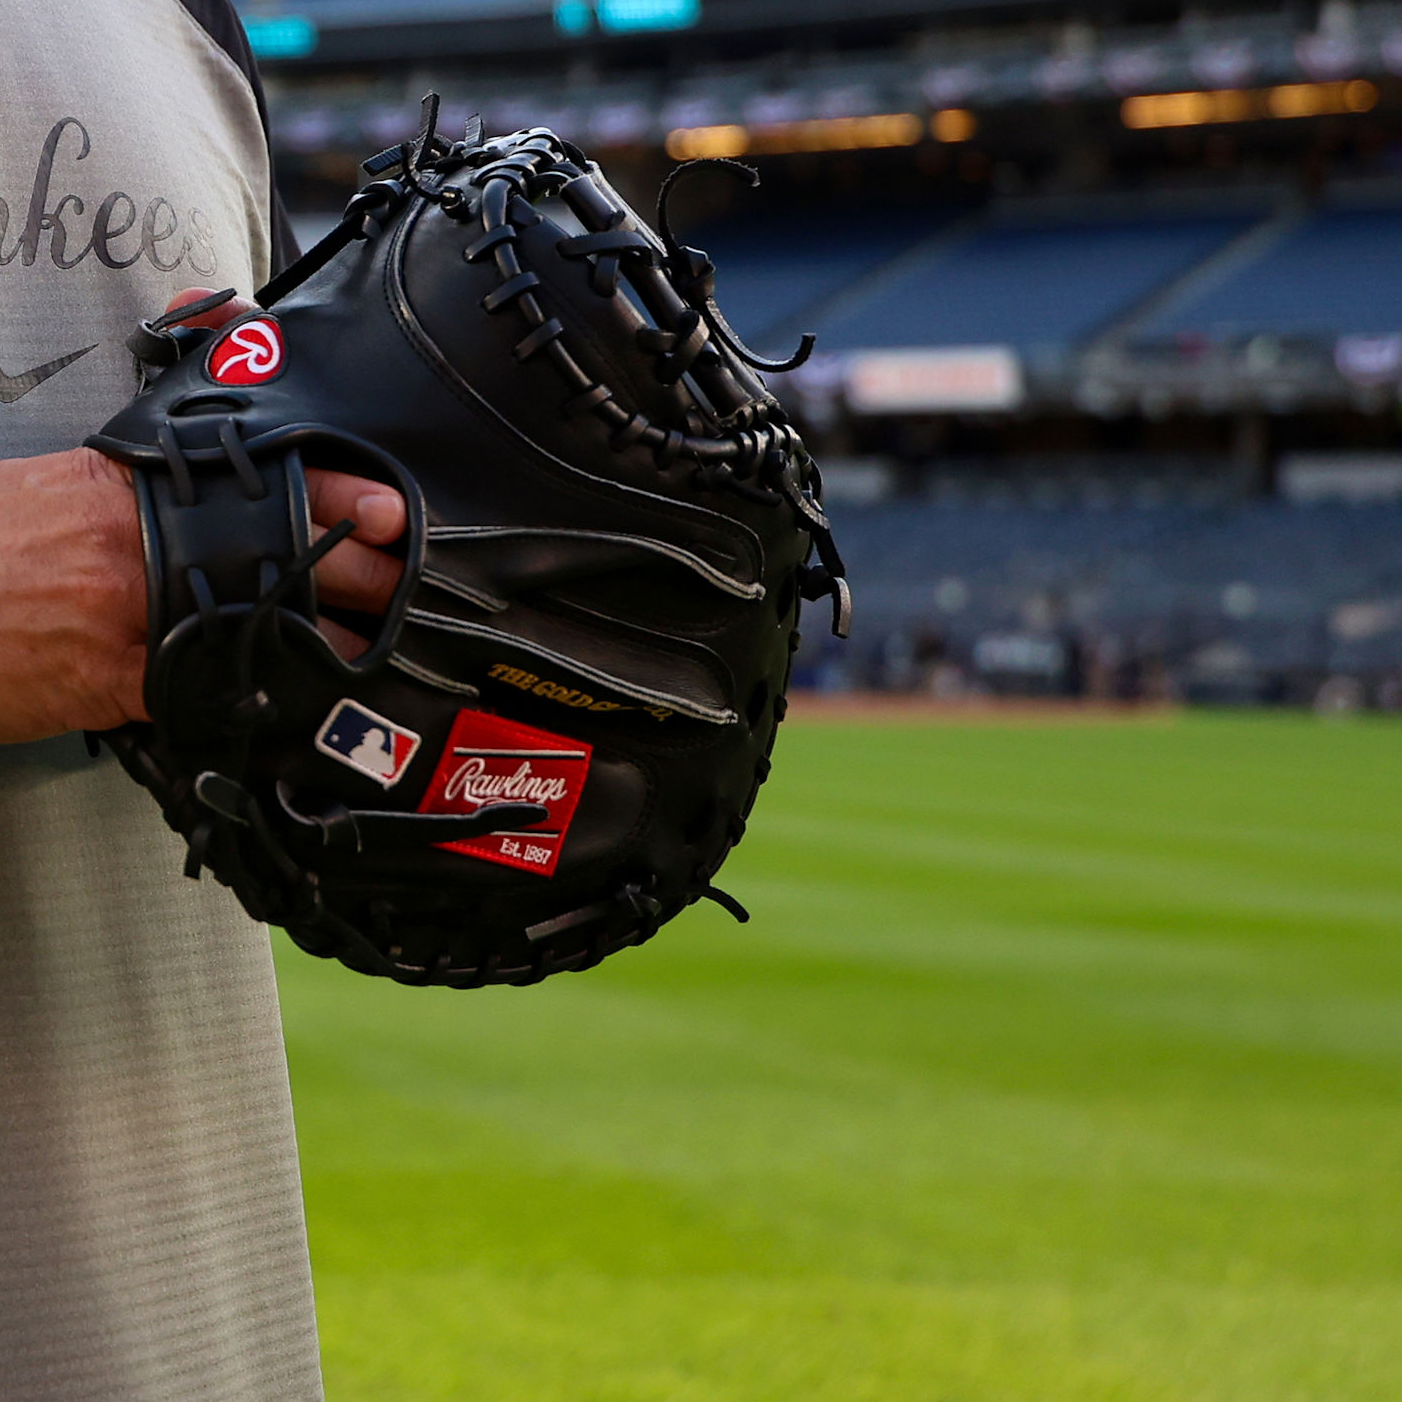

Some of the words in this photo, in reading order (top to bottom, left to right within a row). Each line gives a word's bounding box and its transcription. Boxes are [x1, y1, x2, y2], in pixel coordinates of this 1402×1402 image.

[487, 663, 540, 691] THE
[532, 680, 594, 708] GOLD
[444, 757, 568, 806] Rawlings
[499, 838, 523, 858] Est.
[523, 844, 553, 864] 1887
